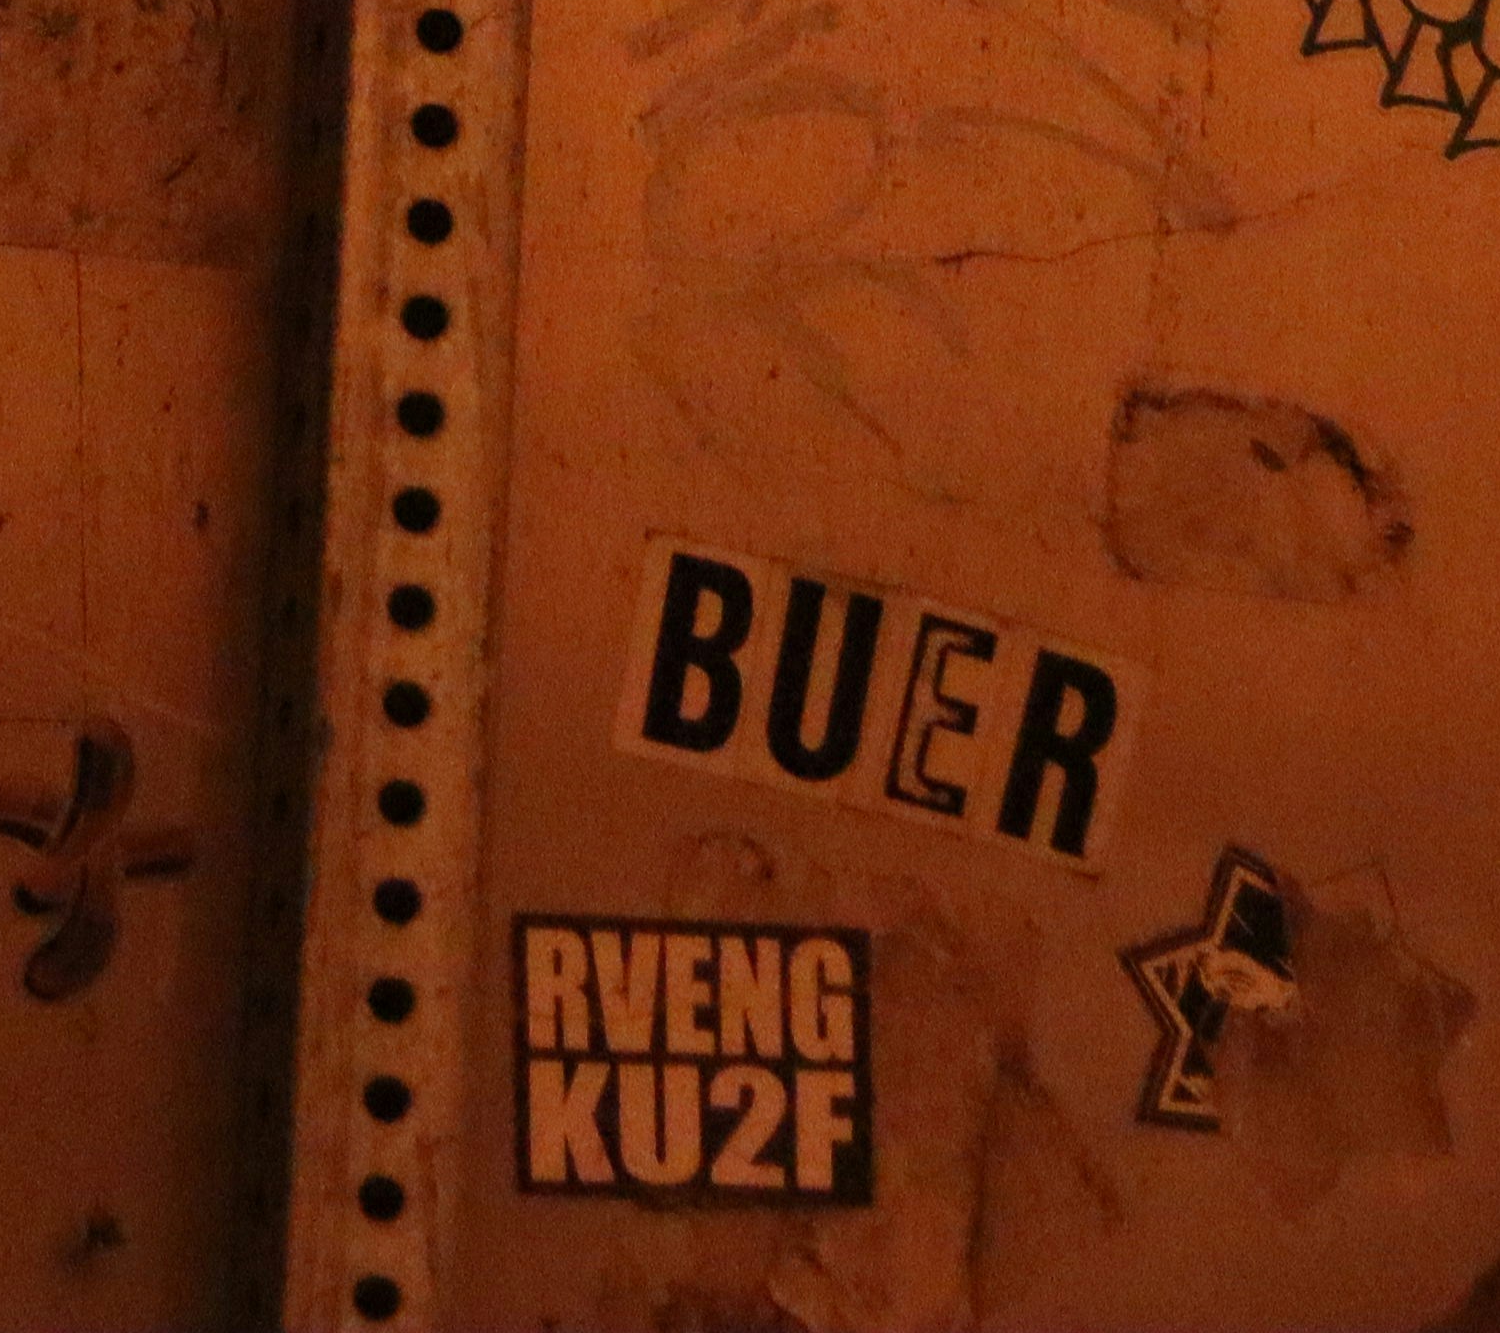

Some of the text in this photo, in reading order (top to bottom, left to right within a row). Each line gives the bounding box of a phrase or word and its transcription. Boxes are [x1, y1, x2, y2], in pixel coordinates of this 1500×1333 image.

[640, 551, 1118, 859] BUER
[524, 926, 856, 1064] RVENG
[526, 1057, 858, 1195] KU2F
